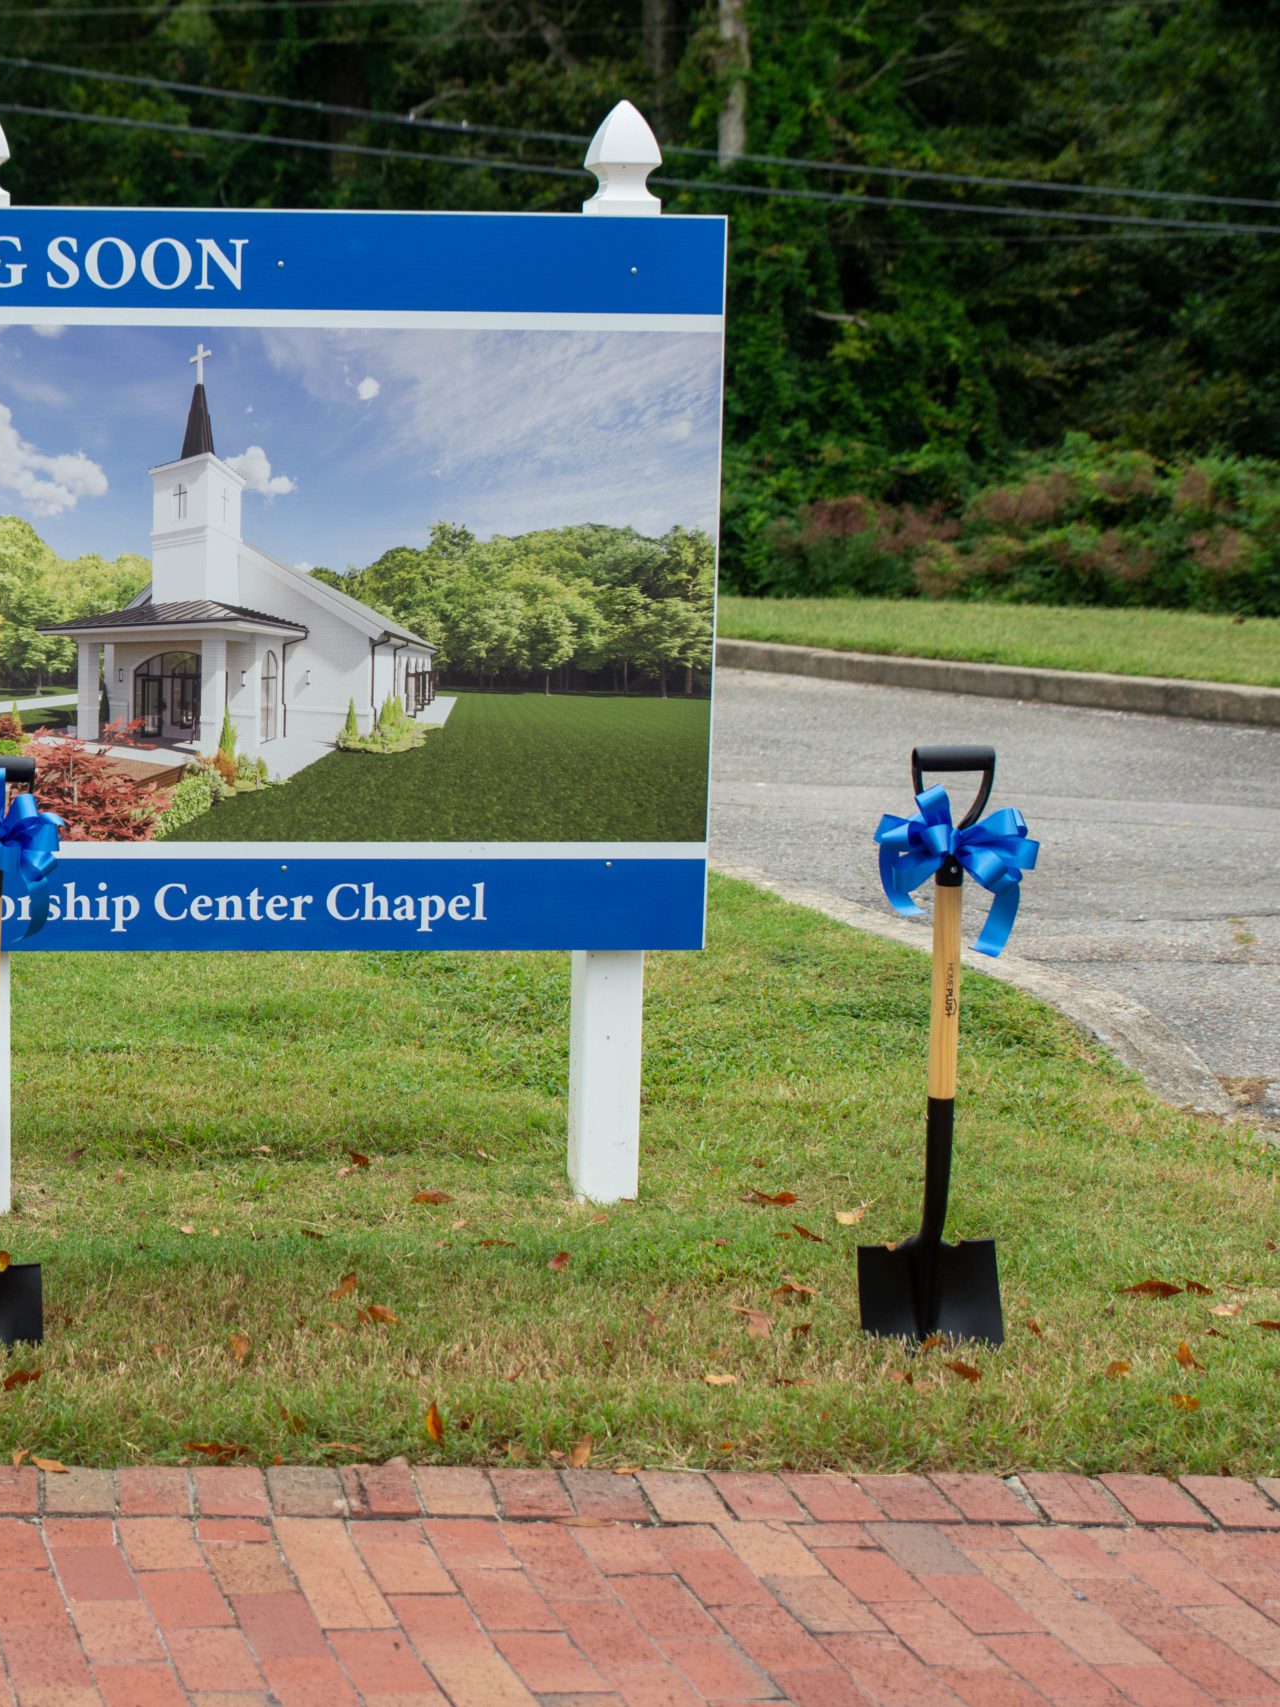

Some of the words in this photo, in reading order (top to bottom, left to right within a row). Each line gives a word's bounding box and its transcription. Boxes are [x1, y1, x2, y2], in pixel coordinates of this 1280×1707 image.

[46, 236, 249, 290] SOON
[154, 883, 313, 921] Center
[326, 882, 487, 932] Chapel
